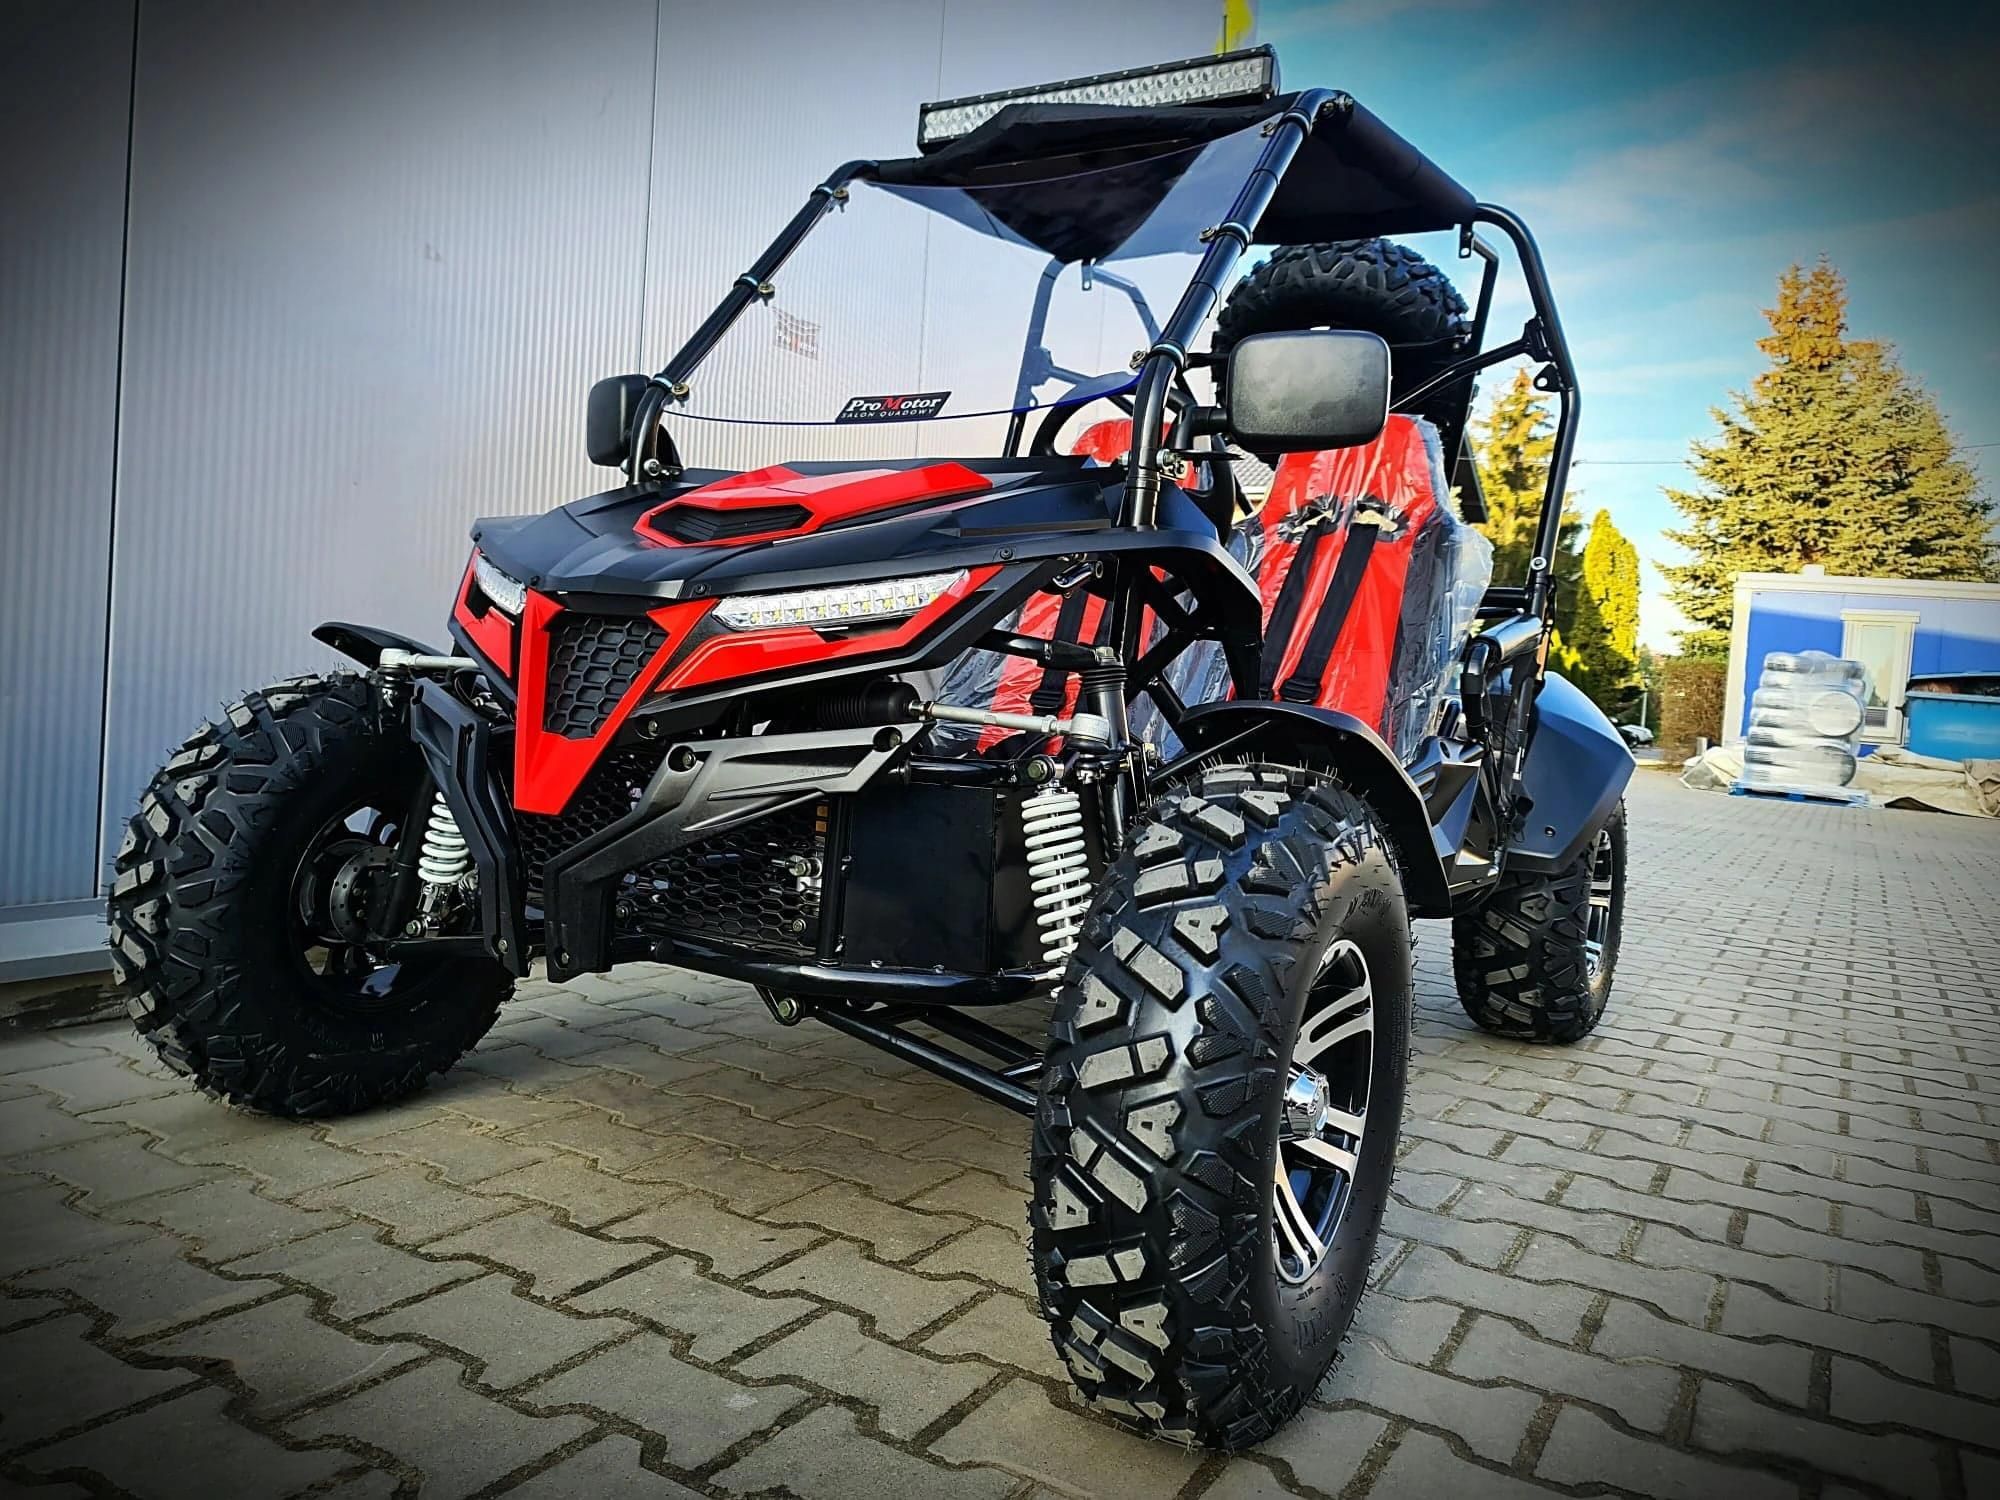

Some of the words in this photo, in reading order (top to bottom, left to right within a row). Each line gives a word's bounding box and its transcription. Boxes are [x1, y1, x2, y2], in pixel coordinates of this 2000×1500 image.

[846, 397, 941, 411] ProMotor
[841, 411, 876, 419] SALON
[879, 408, 935, 418] QUADOWY
